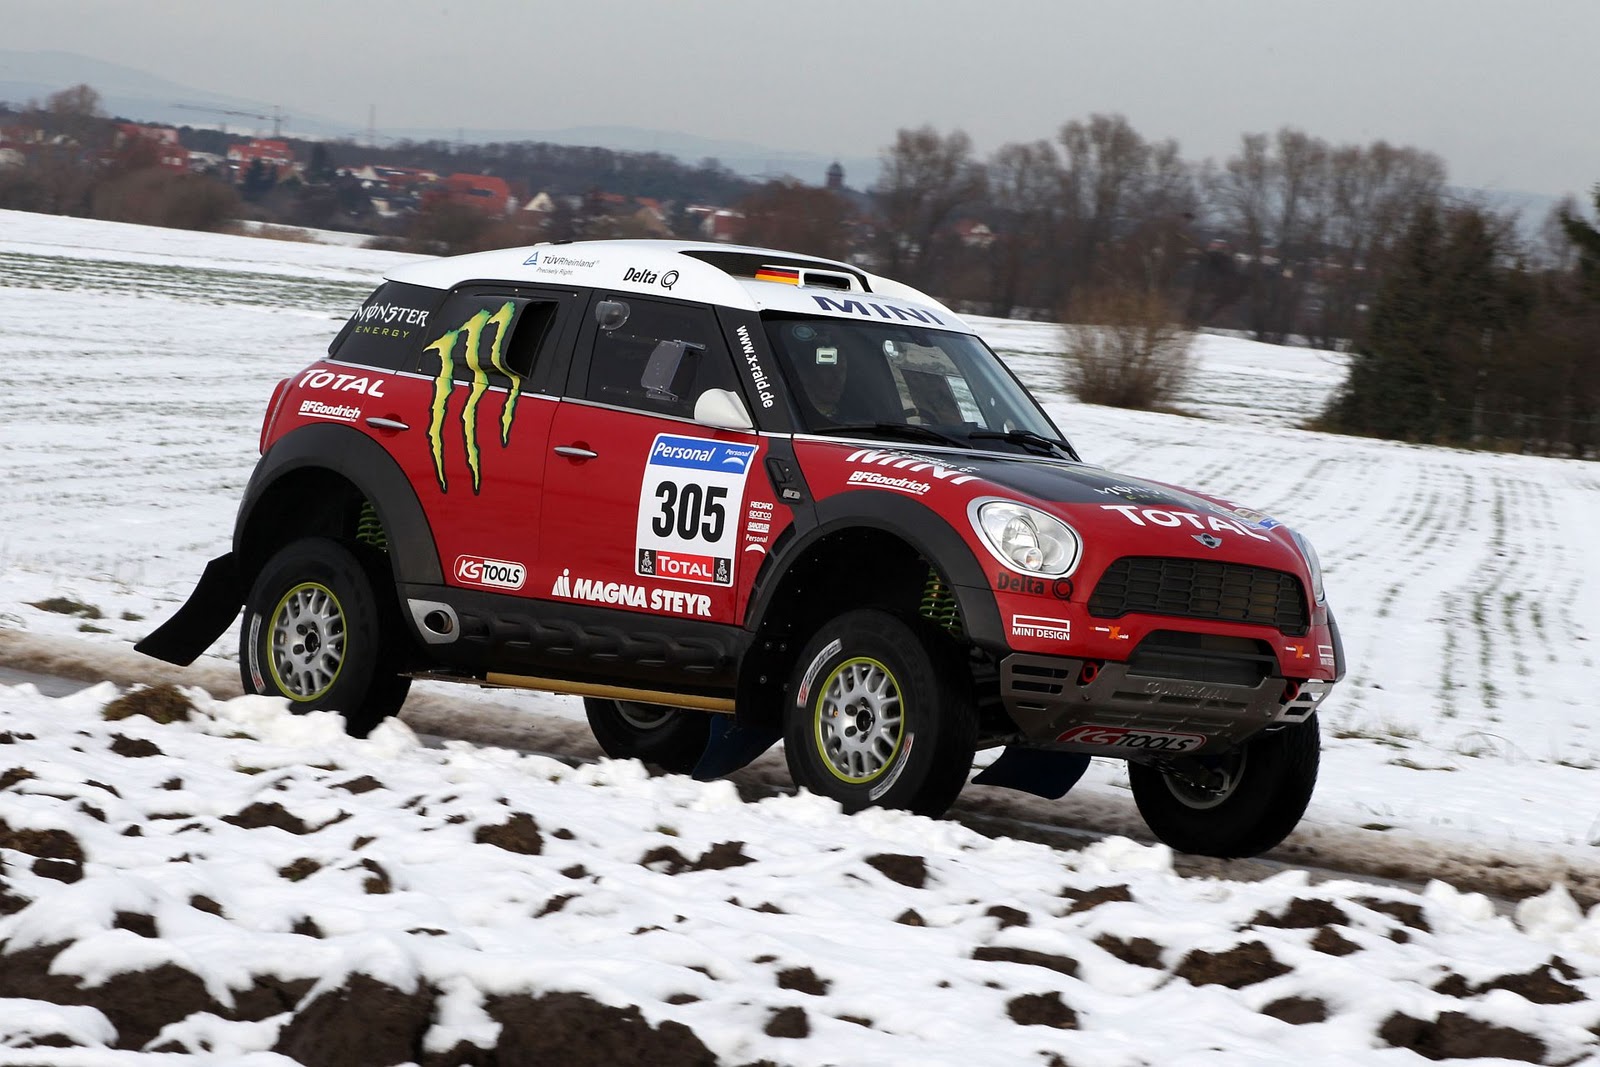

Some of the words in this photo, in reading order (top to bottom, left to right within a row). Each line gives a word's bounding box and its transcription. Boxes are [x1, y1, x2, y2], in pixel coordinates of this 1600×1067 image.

[623, 267, 657, 284] Delta
[812, 295, 945, 326] MINI
[355, 325, 410, 338] ENERGY
[736, 324, 774, 409] www.x-raid.de
[299, 369, 385, 398] TOTAL
[300, 400, 361, 419] BFGoodrich
[654, 442, 716, 462] Personal
[725, 448, 751, 458] Personal
[846, 449, 985, 486] MINI
[849, 470, 931, 493] BFGoodrich
[652, 480, 729, 543] 305
[750, 501, 773, 510] RECARO
[1100, 505, 1271, 542] TOTAL
[745, 534, 768, 543] Personal
[458, 560, 485, 579] KS
[483, 564, 520, 584] TOOLS
[658, 555, 713, 577] TOTAL
[997, 572, 1045, 595] Delta
[573, 578, 647, 608] MAGNA
[651, 589, 712, 617] STEYR
[1012, 627, 1034, 637] MINI
[1036, 629, 1070, 640] DESIGN
[1066, 728, 1117, 745] KS
[1114, 733, 1195, 751] TOOLS
